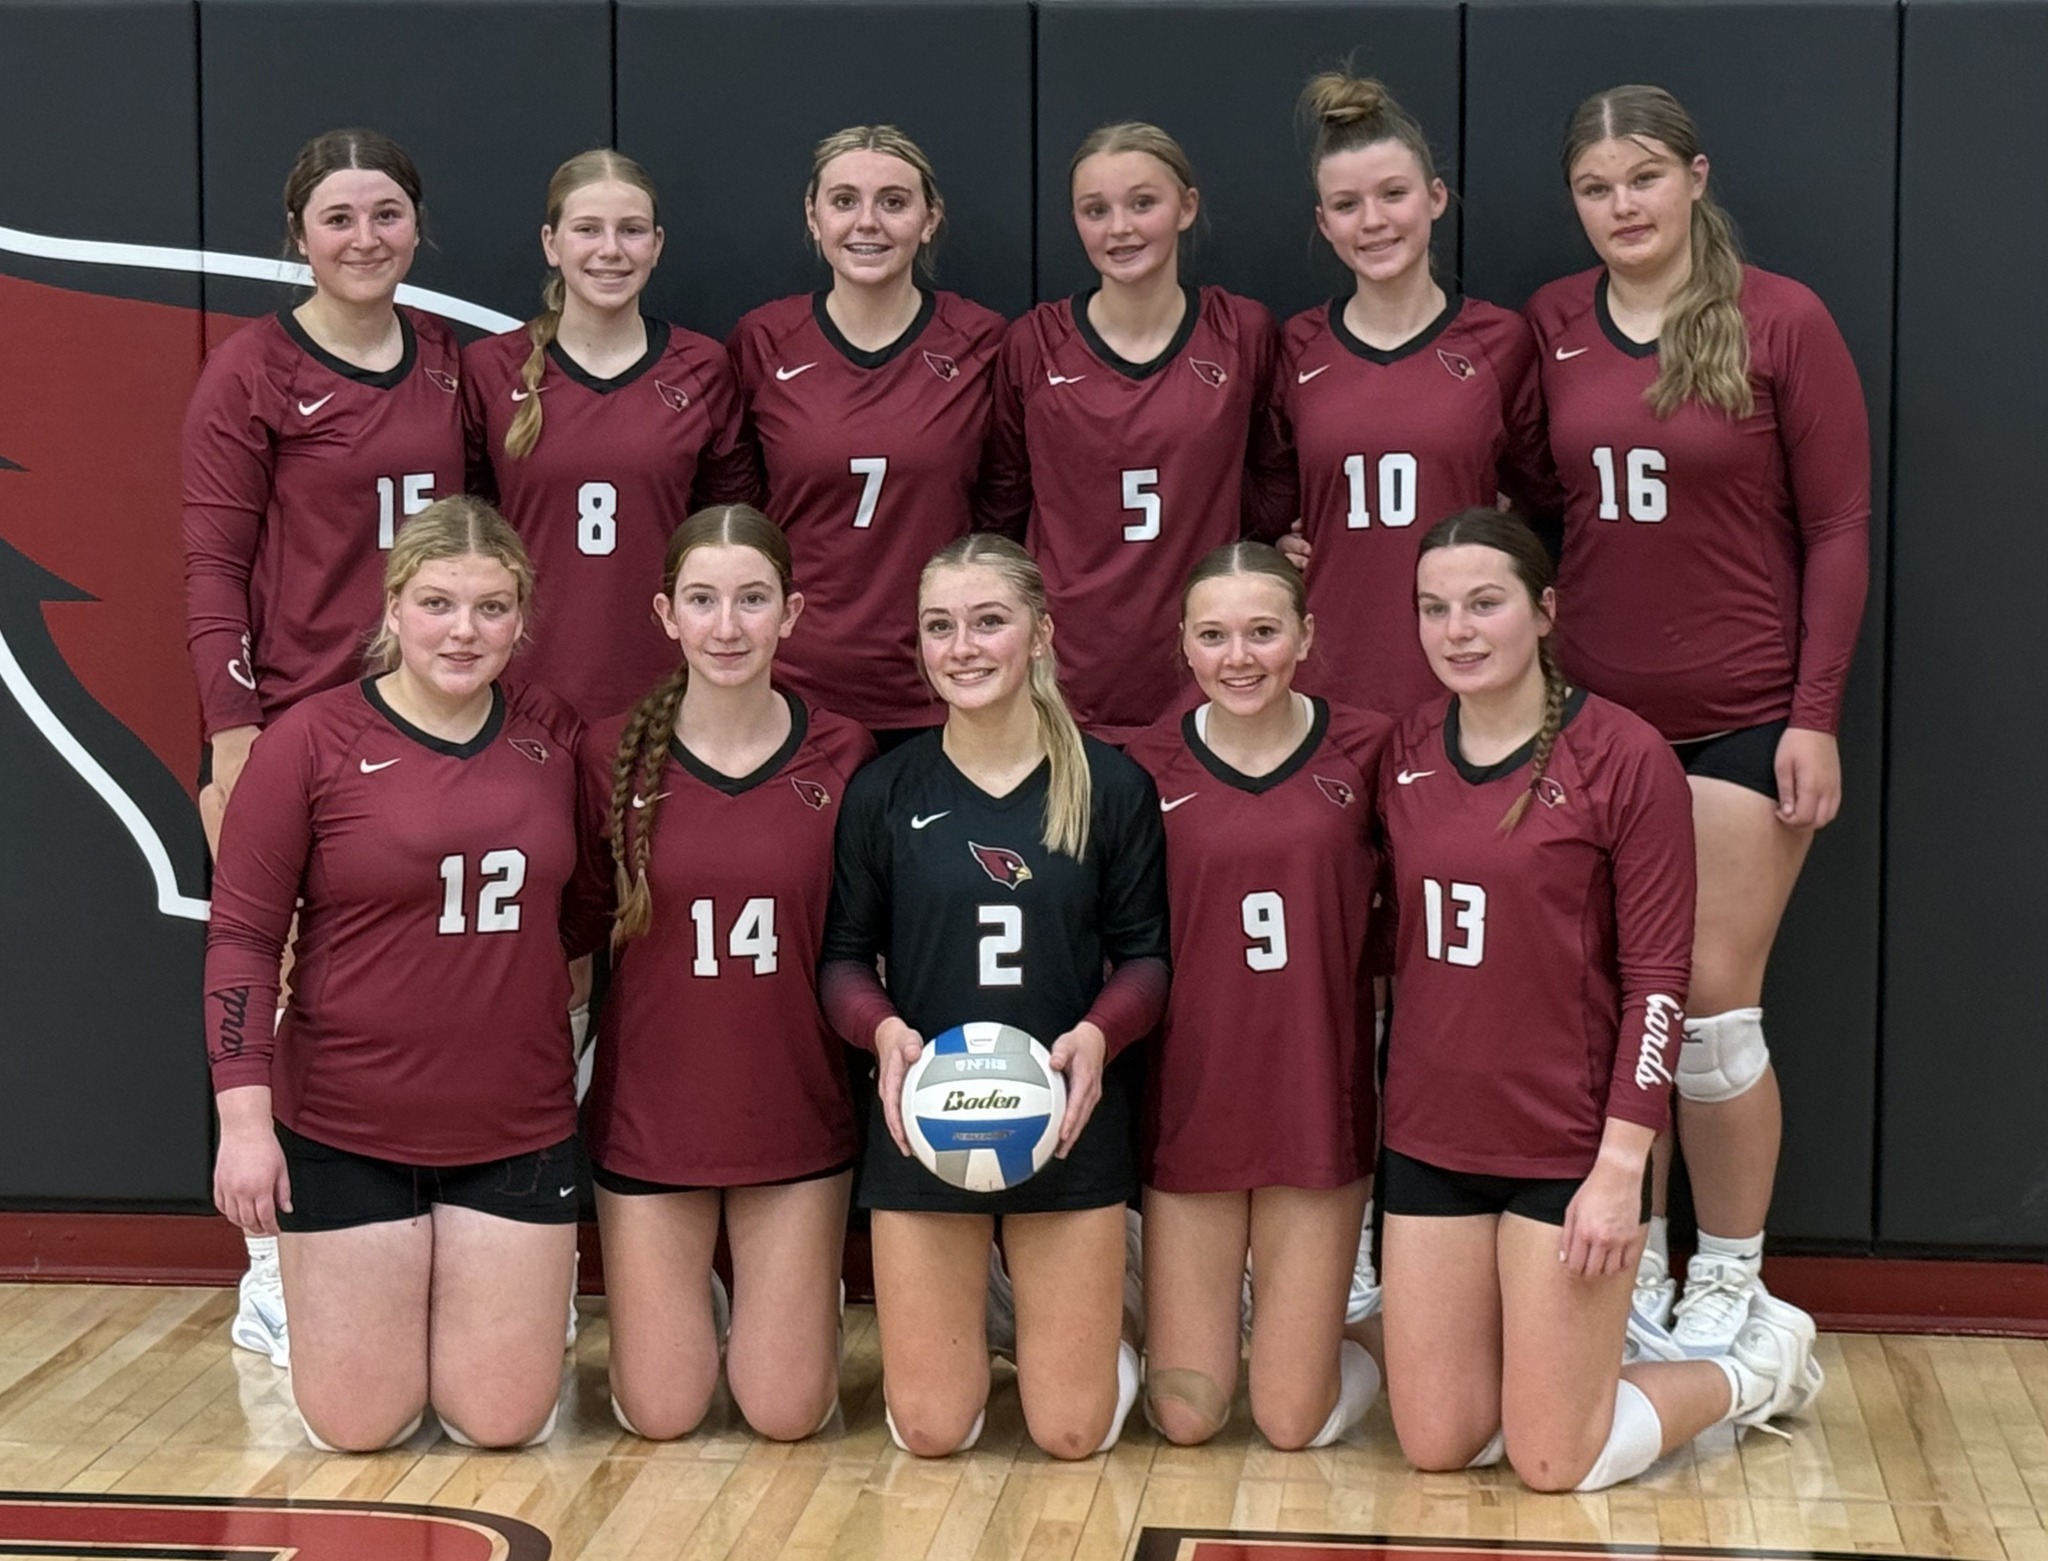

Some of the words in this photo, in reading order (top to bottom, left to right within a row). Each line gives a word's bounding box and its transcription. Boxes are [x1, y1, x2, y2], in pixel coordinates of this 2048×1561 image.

[376, 472, 435, 549] 15
[576, 481, 618, 556] 8
[849, 456, 888, 529] 7
[1121, 467, 1162, 542] 5
[1343, 452, 1418, 530] 10
[1591, 446, 1669, 523] 16
[437, 848, 528, 935] 12
[1422, 878, 1488, 968] 13
[690, 897, 780, 978] 14
[977, 903, 1024, 987] 2
[1240, 890, 1290, 972] 9
[1634, 993, 1685, 1091] Cards
[942, 1089, 1021, 1112] Baden
